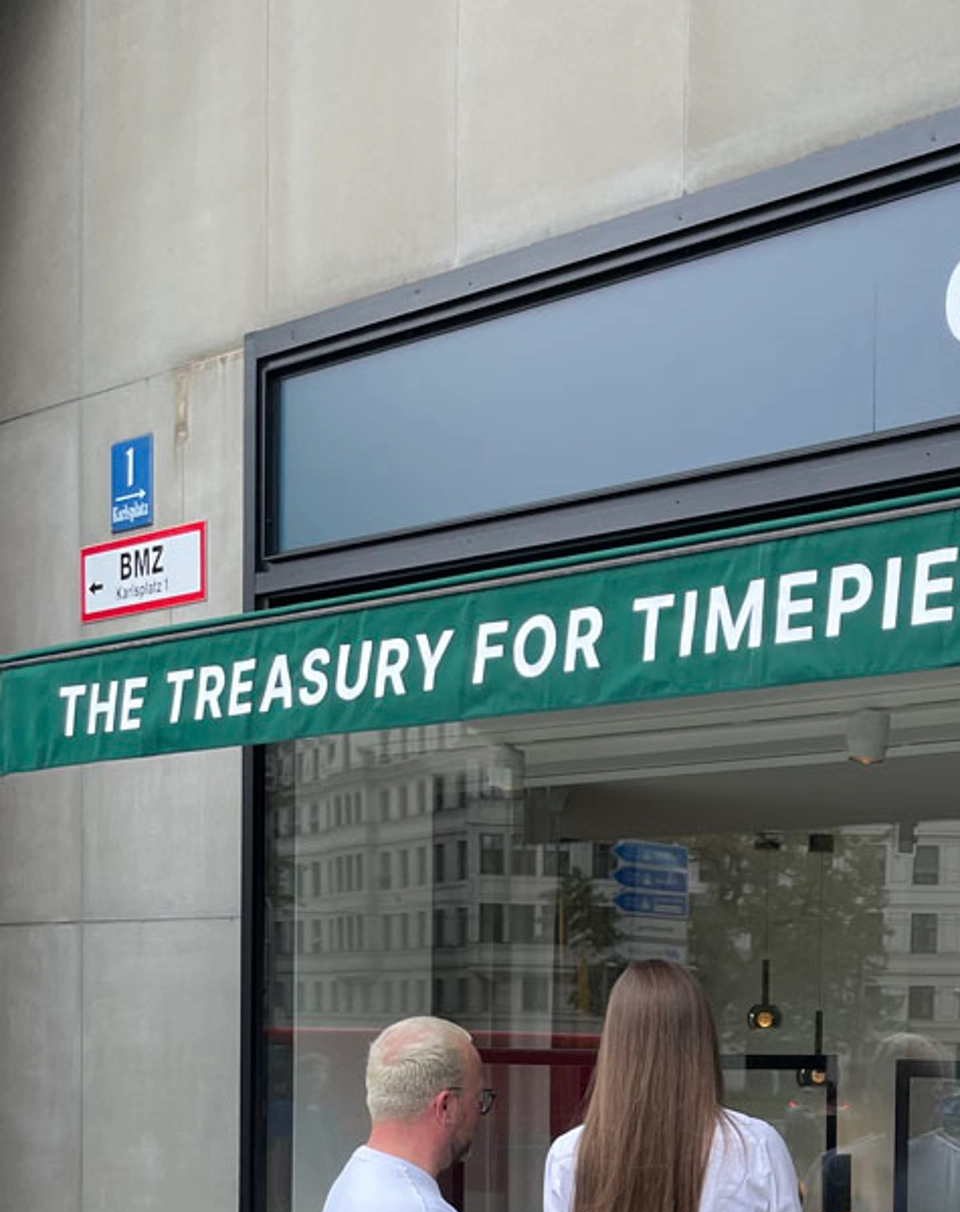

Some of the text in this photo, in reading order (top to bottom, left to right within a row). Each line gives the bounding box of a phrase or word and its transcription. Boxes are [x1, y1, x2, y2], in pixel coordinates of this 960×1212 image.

[126, 447, 135, 487] 1
[113, 500, 149, 523] Karlsplatz
[120, 545, 164, 580] BMZ
[116, 581, 162, 599] Karlsplatz
[59, 680, 148, 737] THE
[166, 629, 455, 724] TREASURY
[471, 605, 603, 685] FOR
